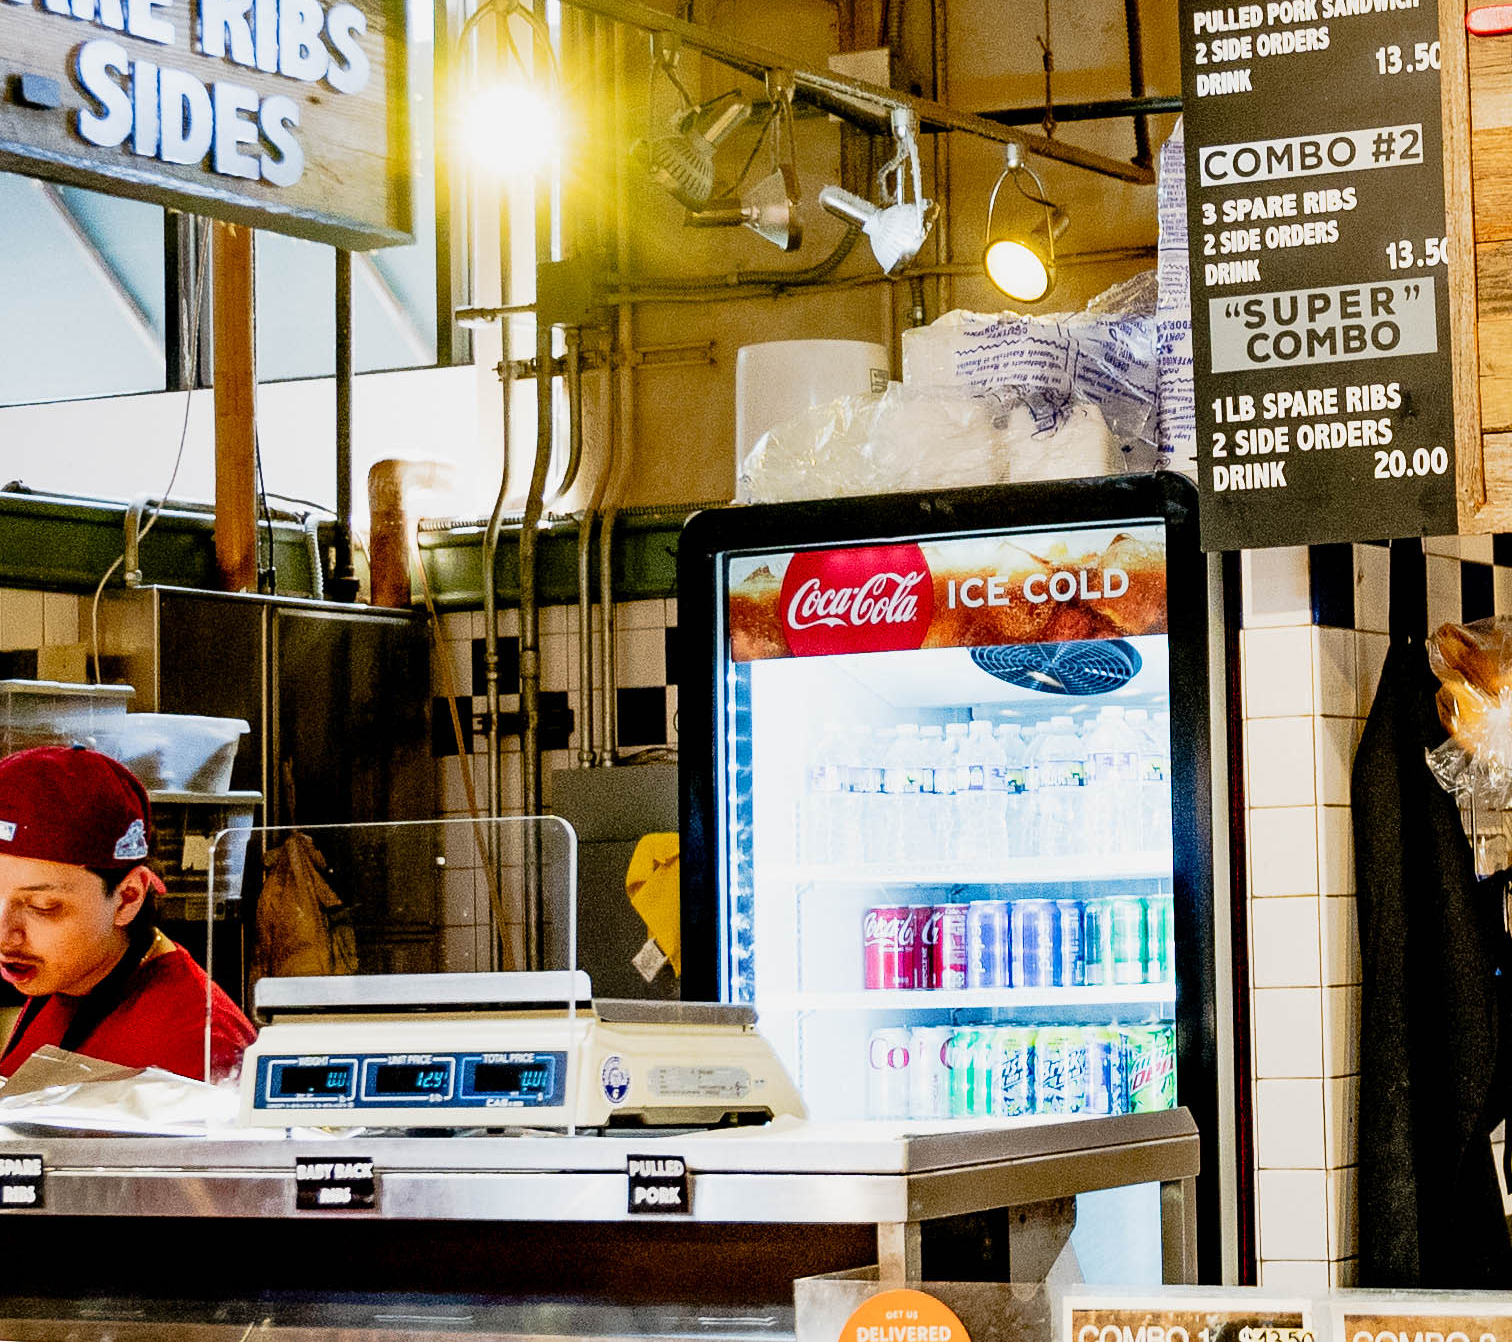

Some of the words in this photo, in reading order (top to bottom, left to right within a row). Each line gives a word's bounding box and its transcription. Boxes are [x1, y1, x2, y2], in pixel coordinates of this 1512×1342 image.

[1193, 3, 1263, 35] PULLED
[1196, 42, 1206, 65] 2
[1212, 36, 1252, 62] SIDE
[1257, 27, 1330, 58] ORDERS
[1196, 69, 1252, 98] DRINK
[75, 42, 306, 186] SIDES
[1204, 137, 1357, 179] COMBO
[1374, 129, 1421, 160] #2
[1202, 201, 1217, 226] 3
[1222, 193, 1296, 223] SPARE
[1301, 187, 1357, 214] RIBS
[1204, 232, 1216, 256] 2
[1221, 227, 1262, 253] SIDE
[1266, 220, 1339, 247] ORDERS
[1206, 260, 1260, 287] DRINK
[1246, 324, 1402, 362] COMBO
[1263, 389, 1339, 420] SPARE
[1345, 382, 1402, 413] RIBS
[1213, 433, 1224, 457] 2
[1231, 429, 1289, 454] SIDE
[1296, 419, 1393, 449] ORDERS
[1213, 461, 1287, 492] DRINK
[1374, 447, 1447, 479] 20.00
[788, 570, 926, 630] Coca-Cola
[948, 577, 1010, 610] ICE
[1023, 568, 1129, 604] COLD
[629, 1160, 684, 1177] PULLED
[635, 1187, 681, 1204] PORK
[906, 1310, 918, 1319] US
[856, 1326, 951, 1342] DELIVERED
